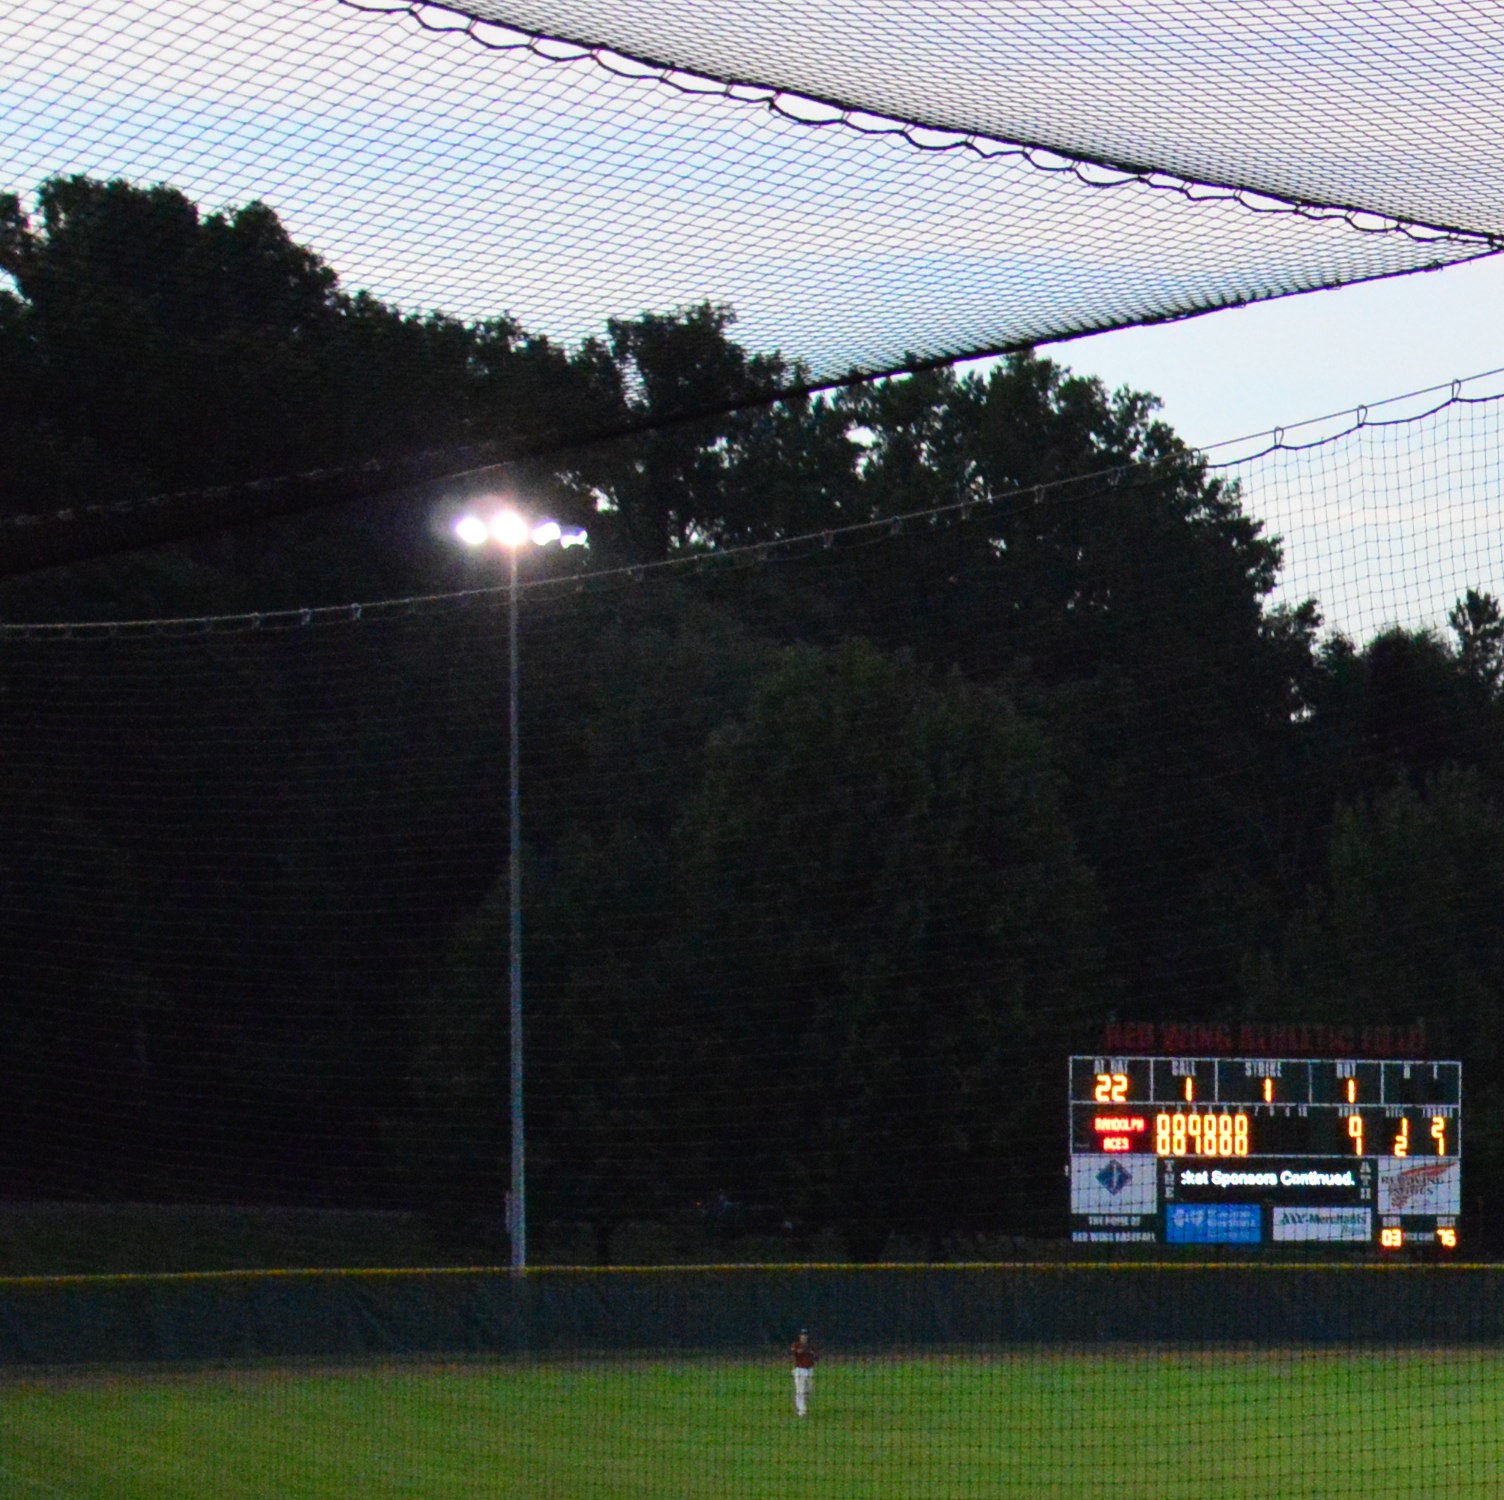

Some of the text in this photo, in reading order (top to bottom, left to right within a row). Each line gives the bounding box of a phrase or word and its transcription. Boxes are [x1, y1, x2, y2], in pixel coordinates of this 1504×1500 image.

[1245, 1061, 1282, 1077] STRIKE
[1094, 1074, 1128, 1102] 22
[1185, 1076, 1193, 1101] 1
[1264, 1077, 1272, 1103] 1
[1348, 1078, 1356, 1104] 1
[1093, 1116, 1146, 1133] RANDOLPH
[1401, 1117, 1408, 1137] 1
[1430, 1116, 1446, 1138] 2
[1102, 1136, 1131, 1151] ACES
[1355, 1136, 1363, 1156] 1
[1394, 1135, 1409, 1157] 2
[1438, 1137, 1445, 1156] 1
[1211, 1169, 1279, 1188] Sponsors
[1280, 1169, 1356, 1186] Continued.
[1381, 1228, 1402, 1247] 03
